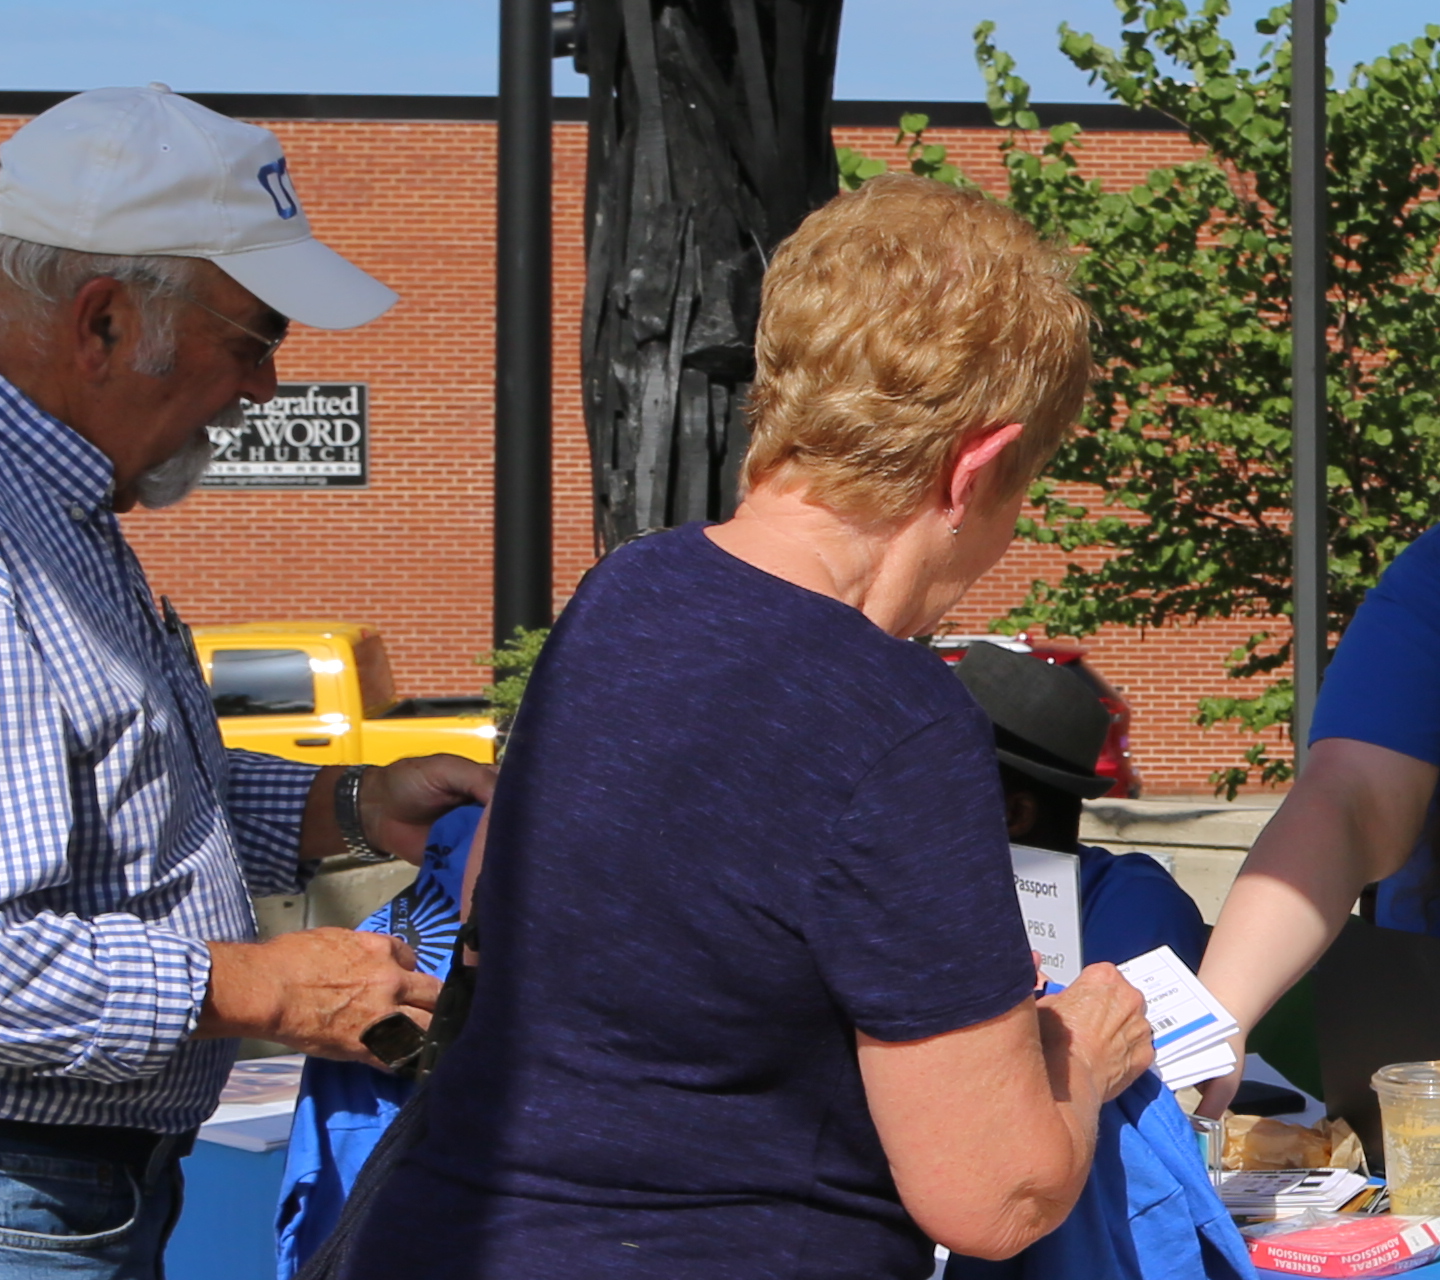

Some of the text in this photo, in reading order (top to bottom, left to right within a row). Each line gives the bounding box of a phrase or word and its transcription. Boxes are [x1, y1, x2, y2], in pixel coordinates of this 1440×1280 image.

[253, 418, 361, 448] WORD
[225, 446, 360, 462] CHURCH
[1027, 919, 1057, 939] PBS &
[1267, 1246, 1328, 1265] ADMISSION
[1340, 1236, 1401, 1263] ADMISSION
[1273, 1257, 1322, 1274] GENERAL
[1348, 1248, 1400, 1273] GENERAL
